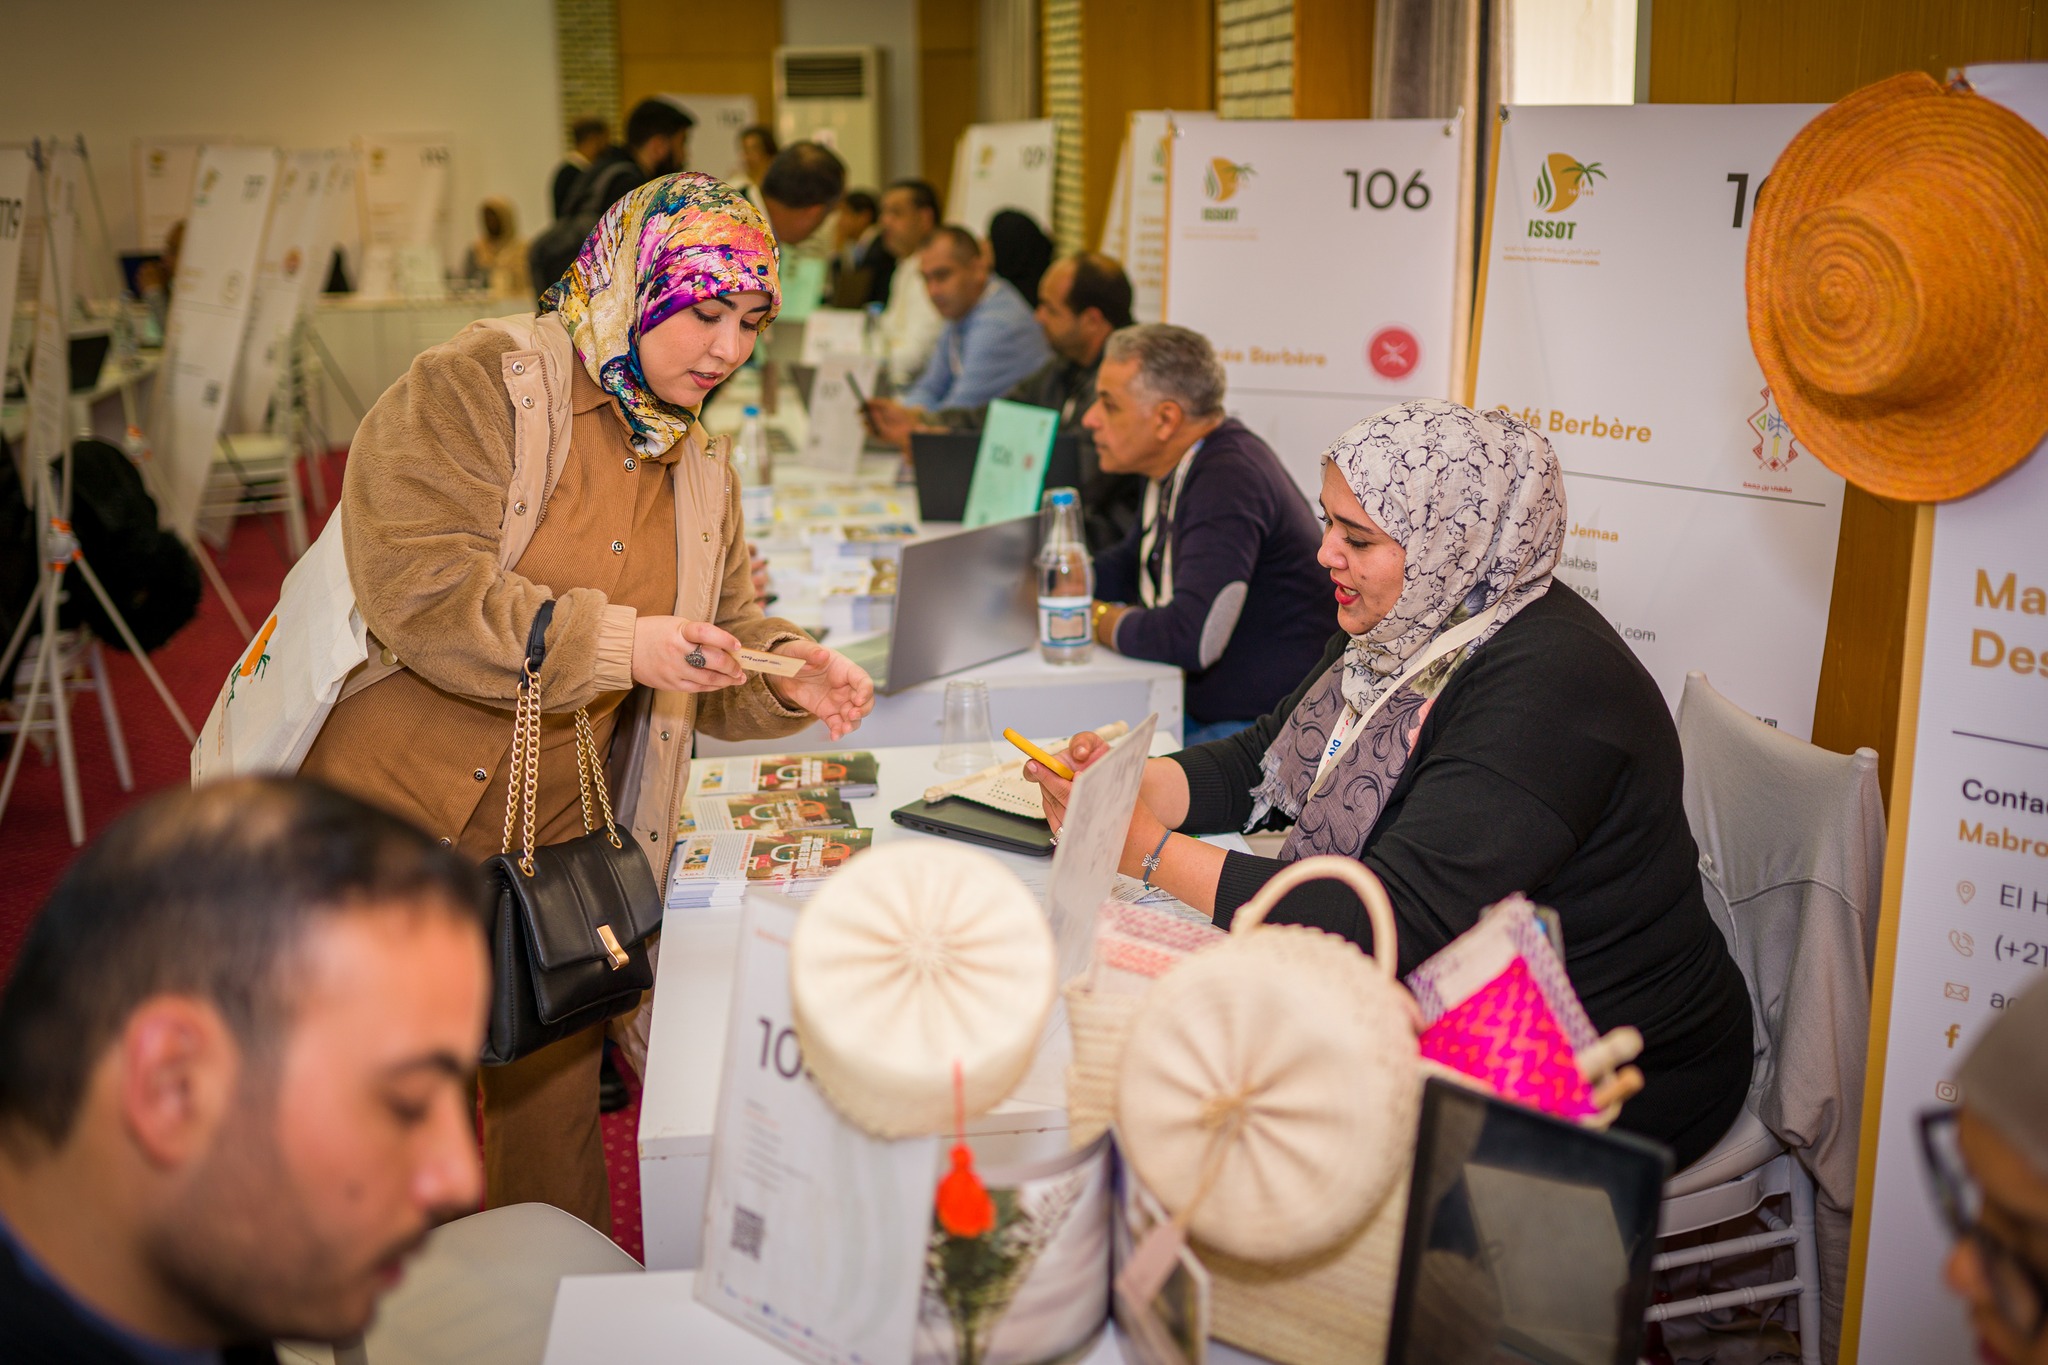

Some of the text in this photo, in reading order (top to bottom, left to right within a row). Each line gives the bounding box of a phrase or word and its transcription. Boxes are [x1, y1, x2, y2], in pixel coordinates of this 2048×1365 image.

[1343, 168, 1432, 210] 106
[1727, 173, 1771, 228] 1
[1528, 219, 1577, 240] ISSOT
[1549, 409, 1652, 443] Berbère
[1570, 522, 1619, 542] Jemaa
[1974, 568, 2047, 616] Ma
[1962, 778, 2048, 815] Conta
[2000, 883, 2024, 909] El
